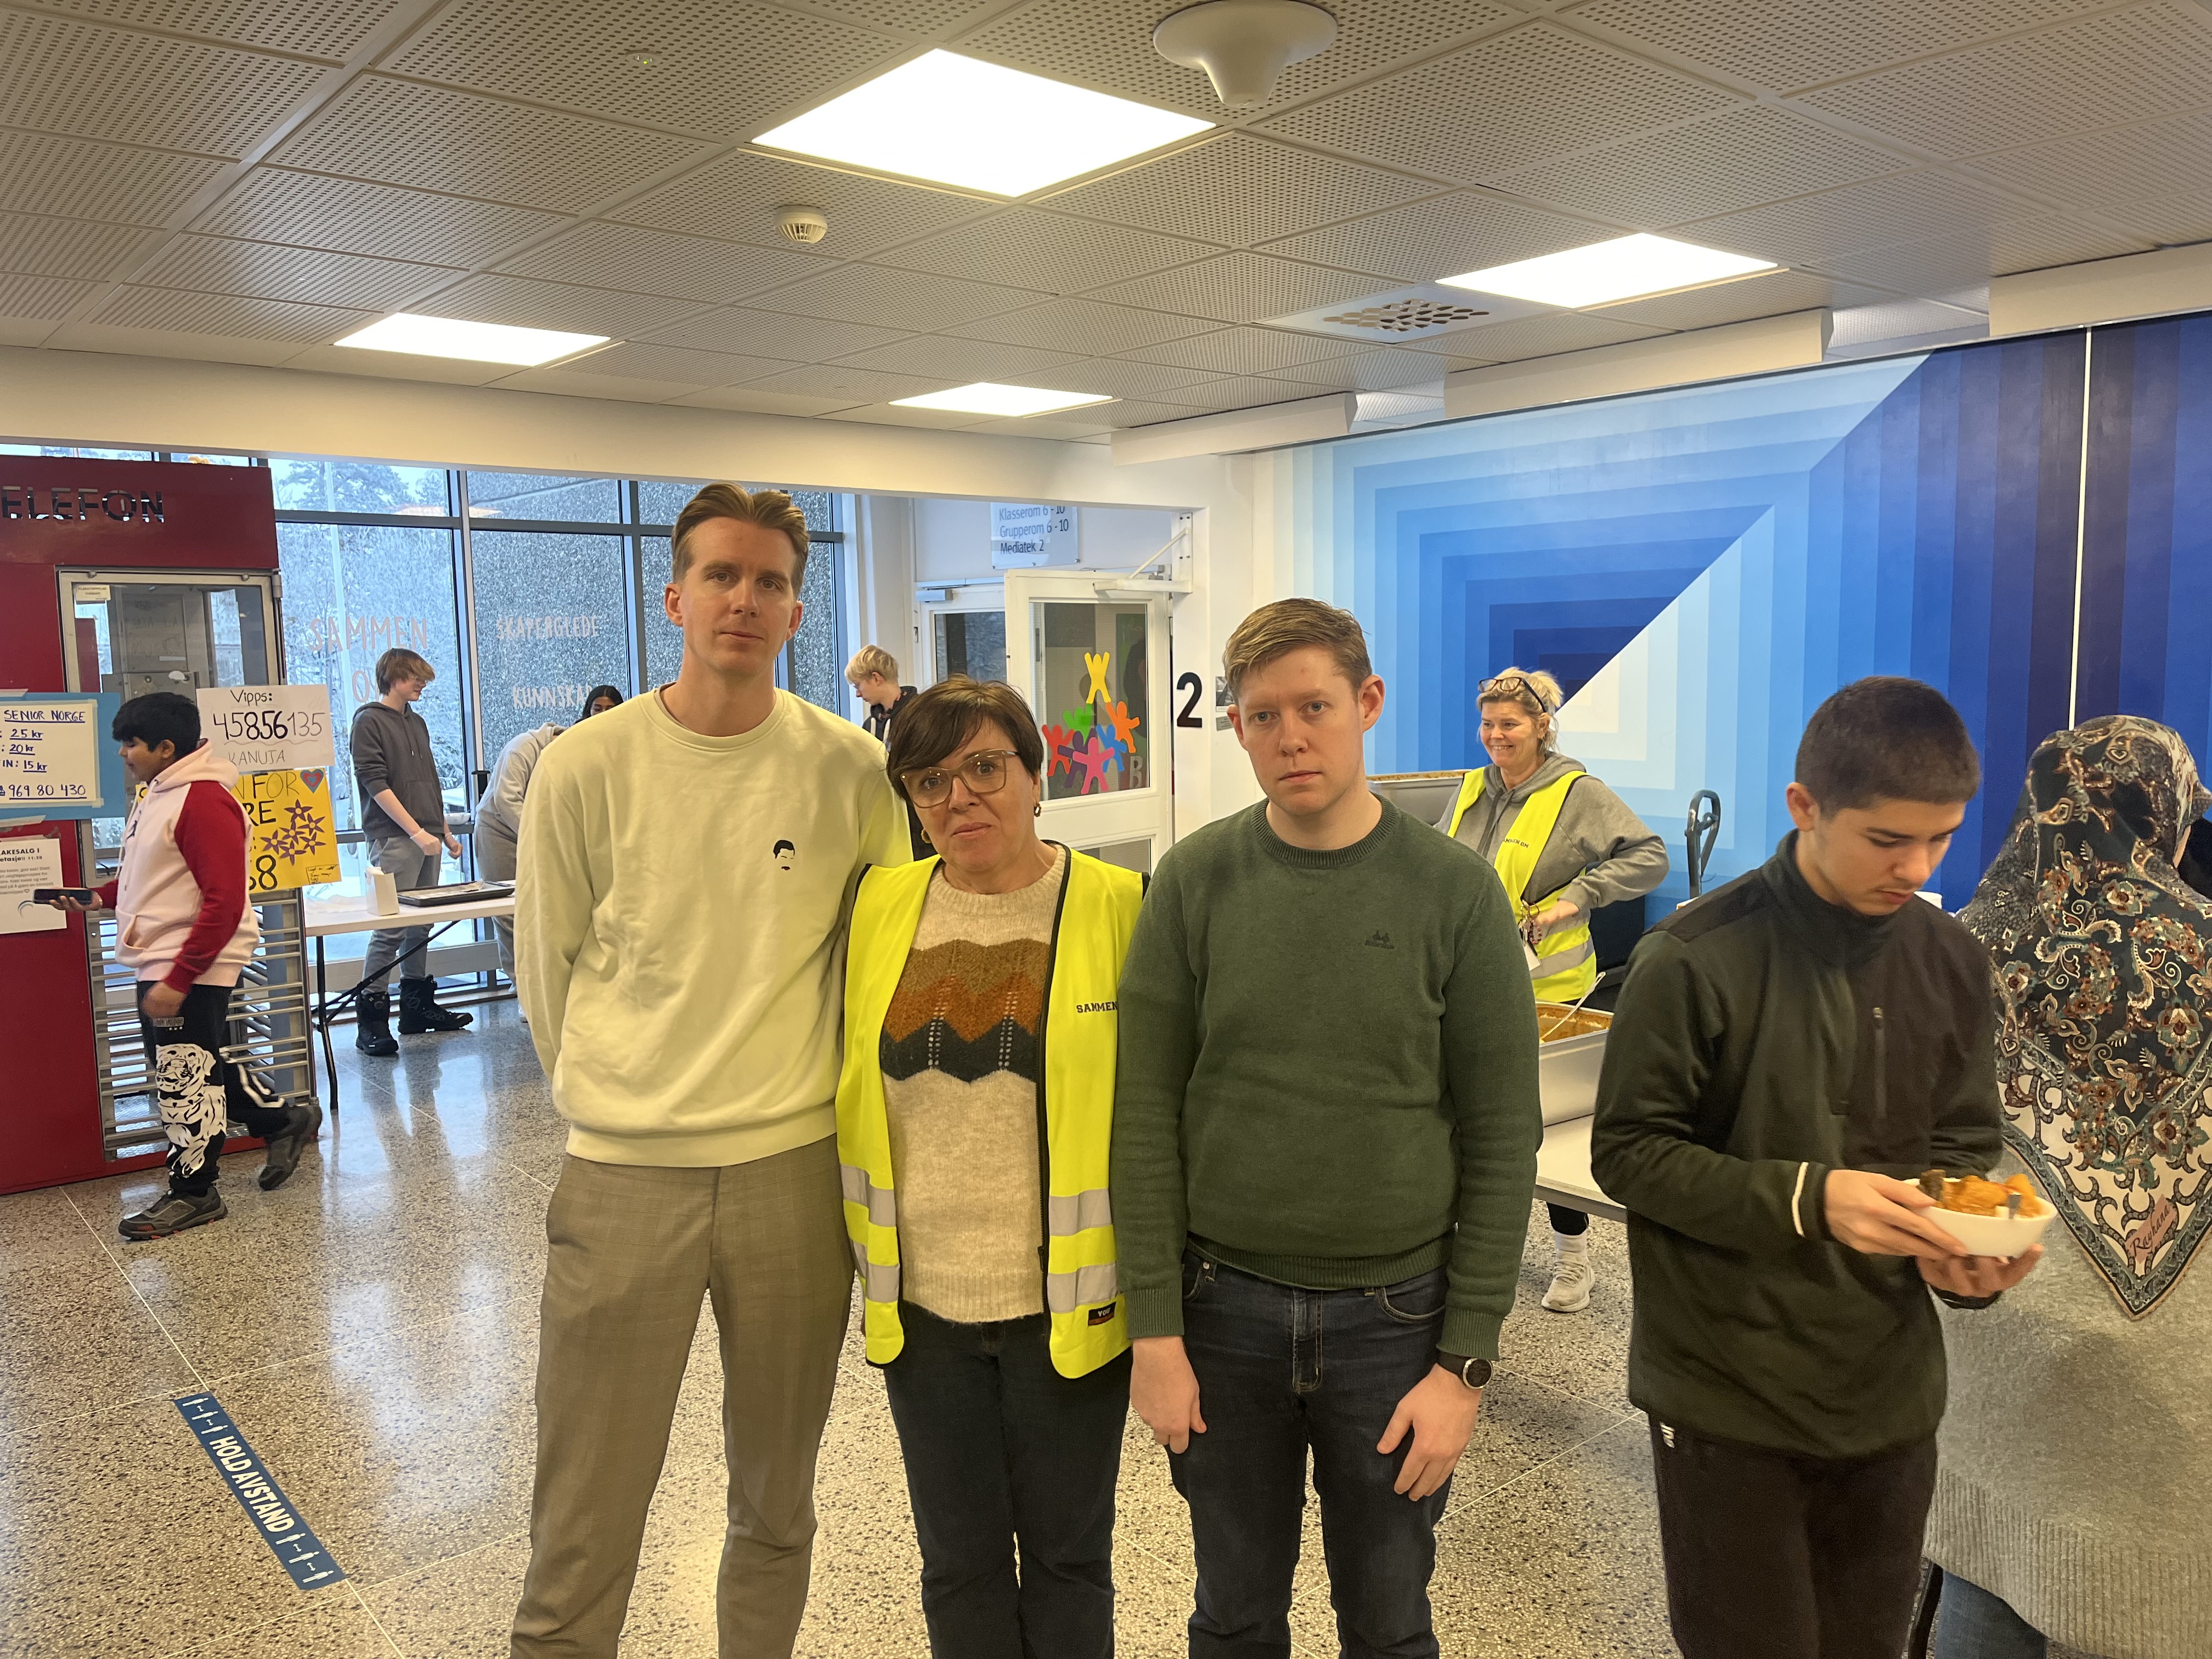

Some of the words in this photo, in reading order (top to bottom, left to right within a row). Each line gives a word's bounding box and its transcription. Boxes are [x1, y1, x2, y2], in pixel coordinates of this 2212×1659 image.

[2, 486, 163, 522] ELEFON
[999, 507, 1041, 521] Klasserom
[1043, 505, 1048, 516] 6
[1056, 506, 1065, 514] 10
[1000, 524, 1044, 539] Grupperom
[1047, 520, 1052, 533] 6
[1059, 518, 1069, 532] 10
[1001, 540, 1036, 555] Mediatek
[1039, 539, 1044, 551] 2
[309, 616, 428, 652] SAMMEN
[496, 614, 599, 640] SKAPERGLEDE
[230, 690, 273, 707] Vipps:
[1176, 672, 1203, 728] 2
[4, 710, 45, 720] SENIOR
[51, 710, 86, 721] NORGE
[10, 729, 28, 738] 25
[31, 730, 43, 738] kr
[213, 710, 325, 741] 45856135
[9, 744, 24, 753] 20
[24, 760, 33, 769] 15
[37, 762, 48, 771] kr
[8, 784, 30, 797] 969
[37, 785, 54, 796] 80
[61, 784, 86, 797] 430
[252, 771, 300, 799] FOR
[1076, 1001, 1118, 1013] SAMMEN
[2130, 1205, 2170, 1257] Rayhana
[1098, 1307, 1111, 1317] YOU
[209, 1435, 252, 1472] HOLD
[231, 1471, 295, 1532] AVSTAND
